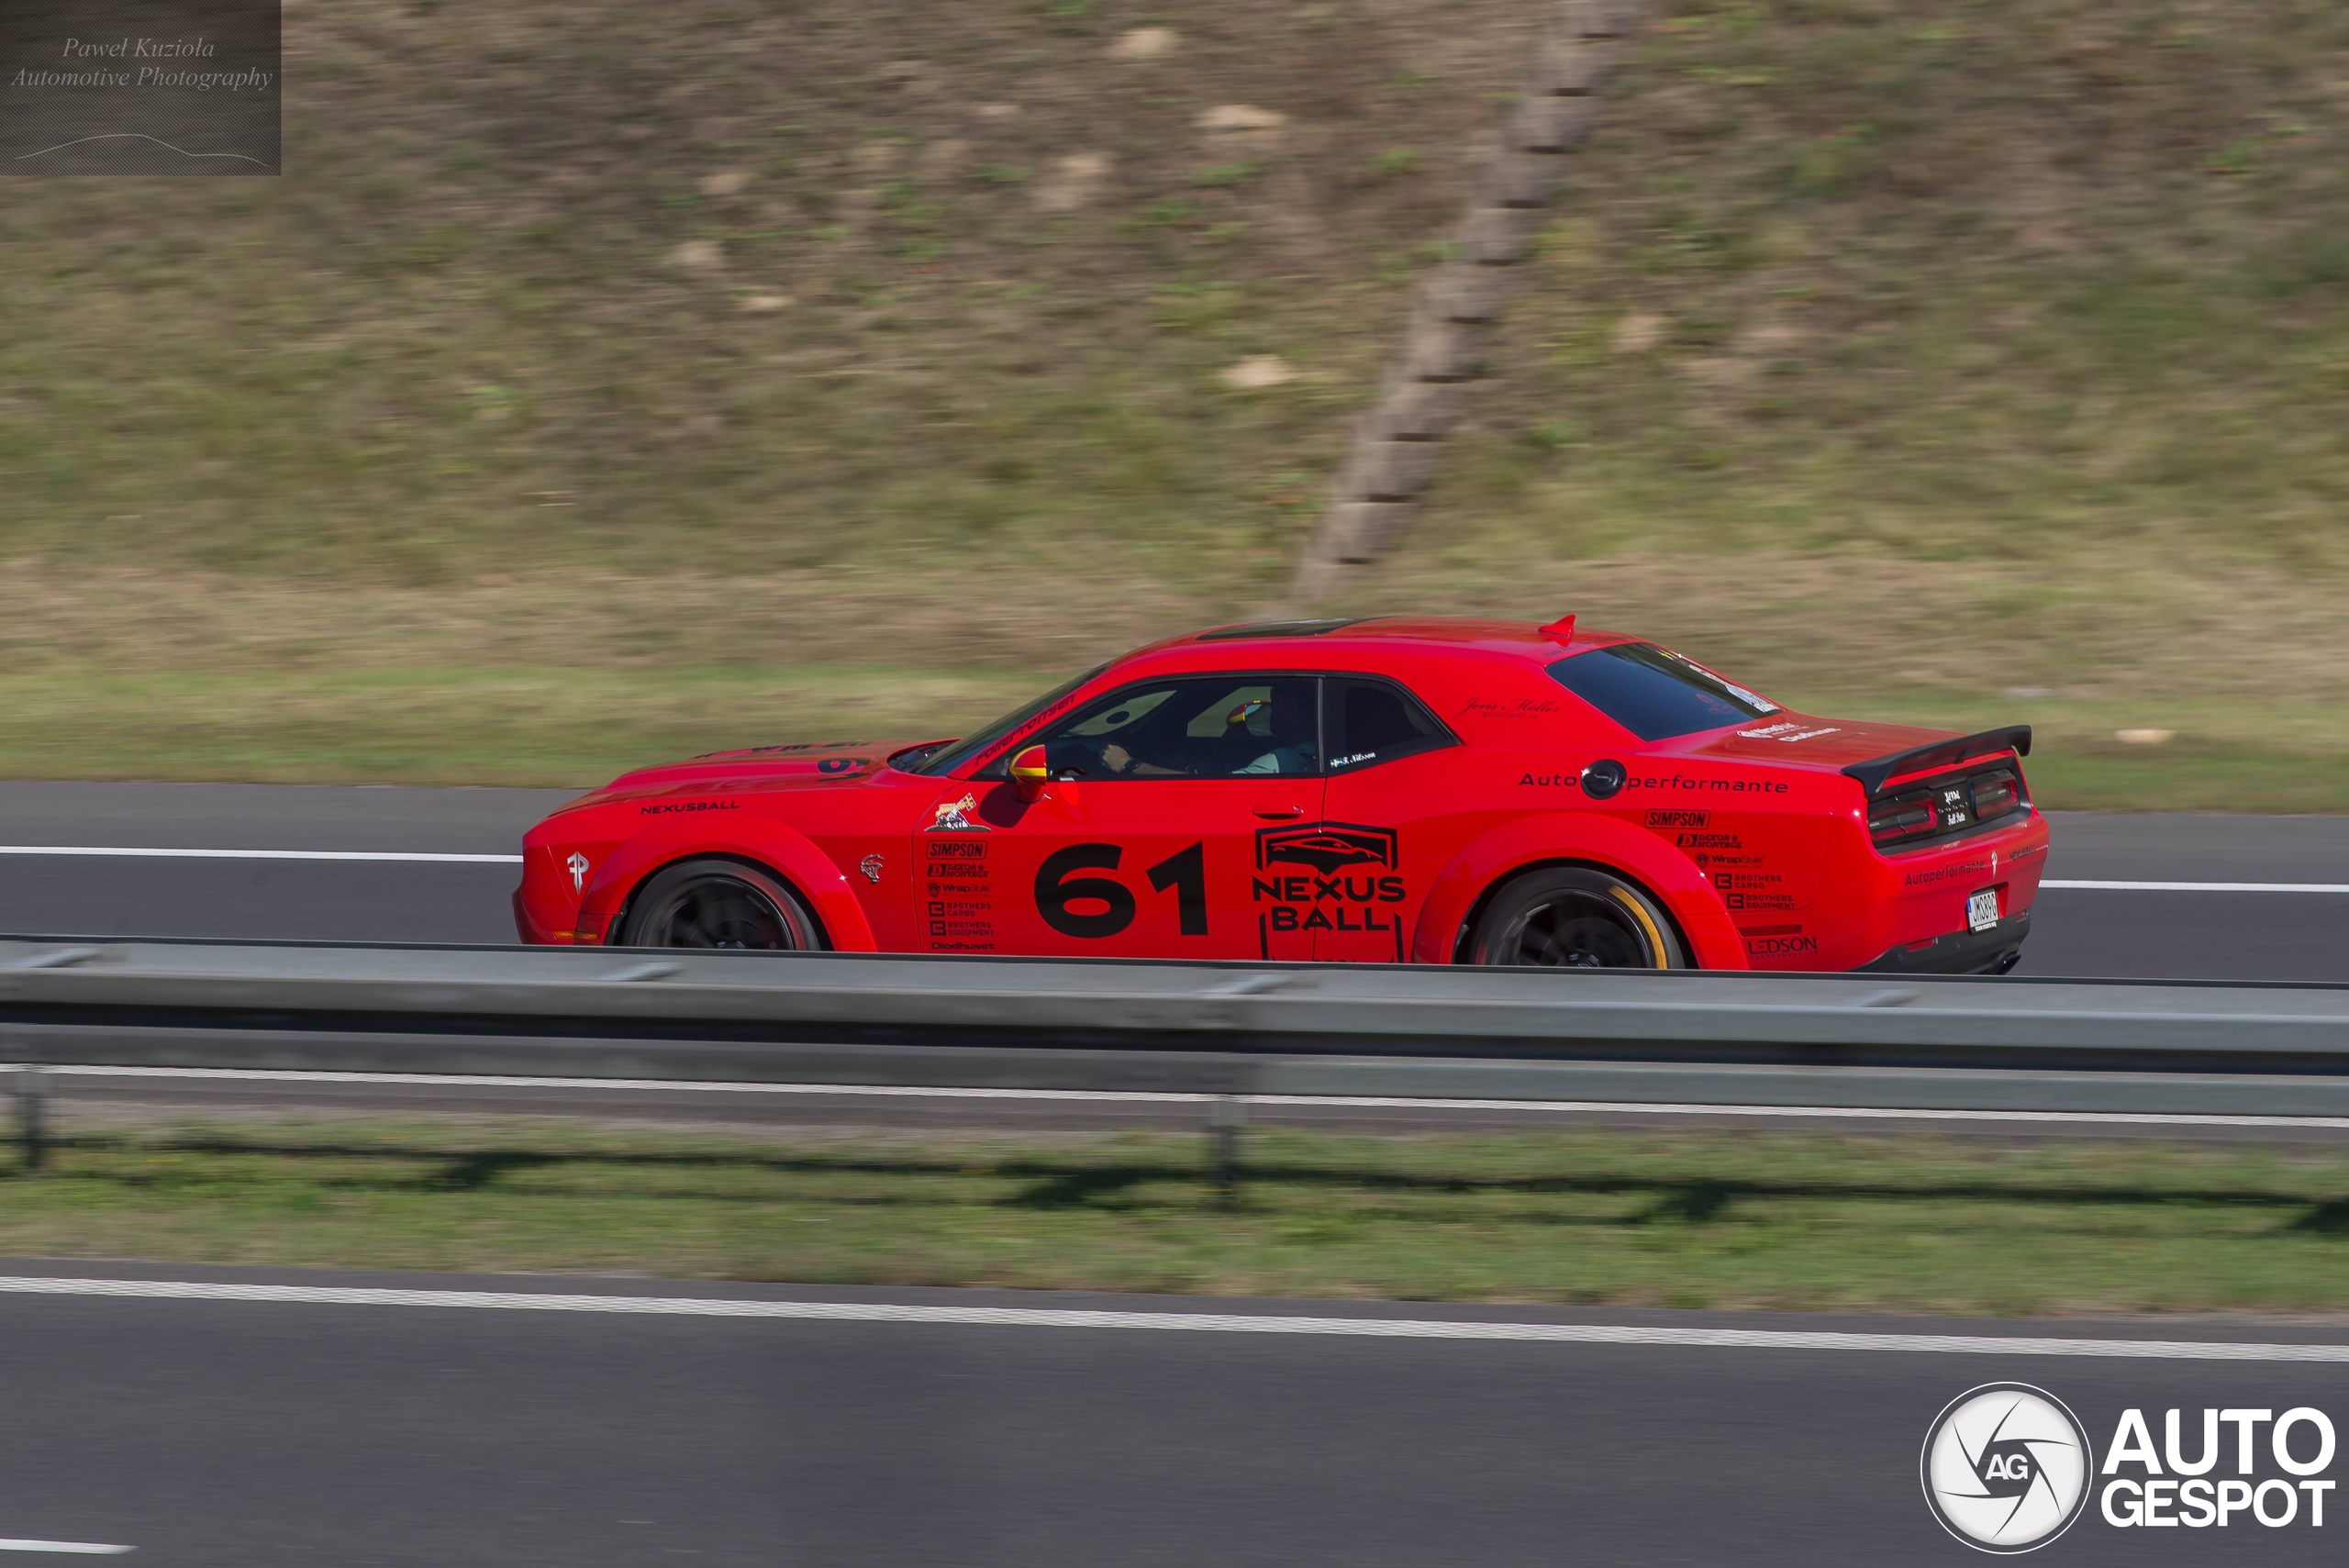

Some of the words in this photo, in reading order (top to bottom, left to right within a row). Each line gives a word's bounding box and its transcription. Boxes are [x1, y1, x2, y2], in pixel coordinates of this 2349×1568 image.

[1519, 773, 1577, 786] Auto
[1626, 774, 1789, 794] performante
[640, 801, 740, 816] NEXUSBALL
[1648, 811, 1707, 827] SIMPSON
[930, 842, 984, 857] SIMPSON
[946, 870, 989, 878] MONTAGE
[1905, 860, 1984, 886] Autoperformante
[1034, 840, 1209, 938] 61
[1252, 874, 1407, 902] NEXUS
[1746, 902, 1796, 910] EQUIPMENT
[1273, 906, 1391, 932] BALL
[931, 941, 995, 950] Diodhuset
[1747, 936, 1817, 954] LEDSON
